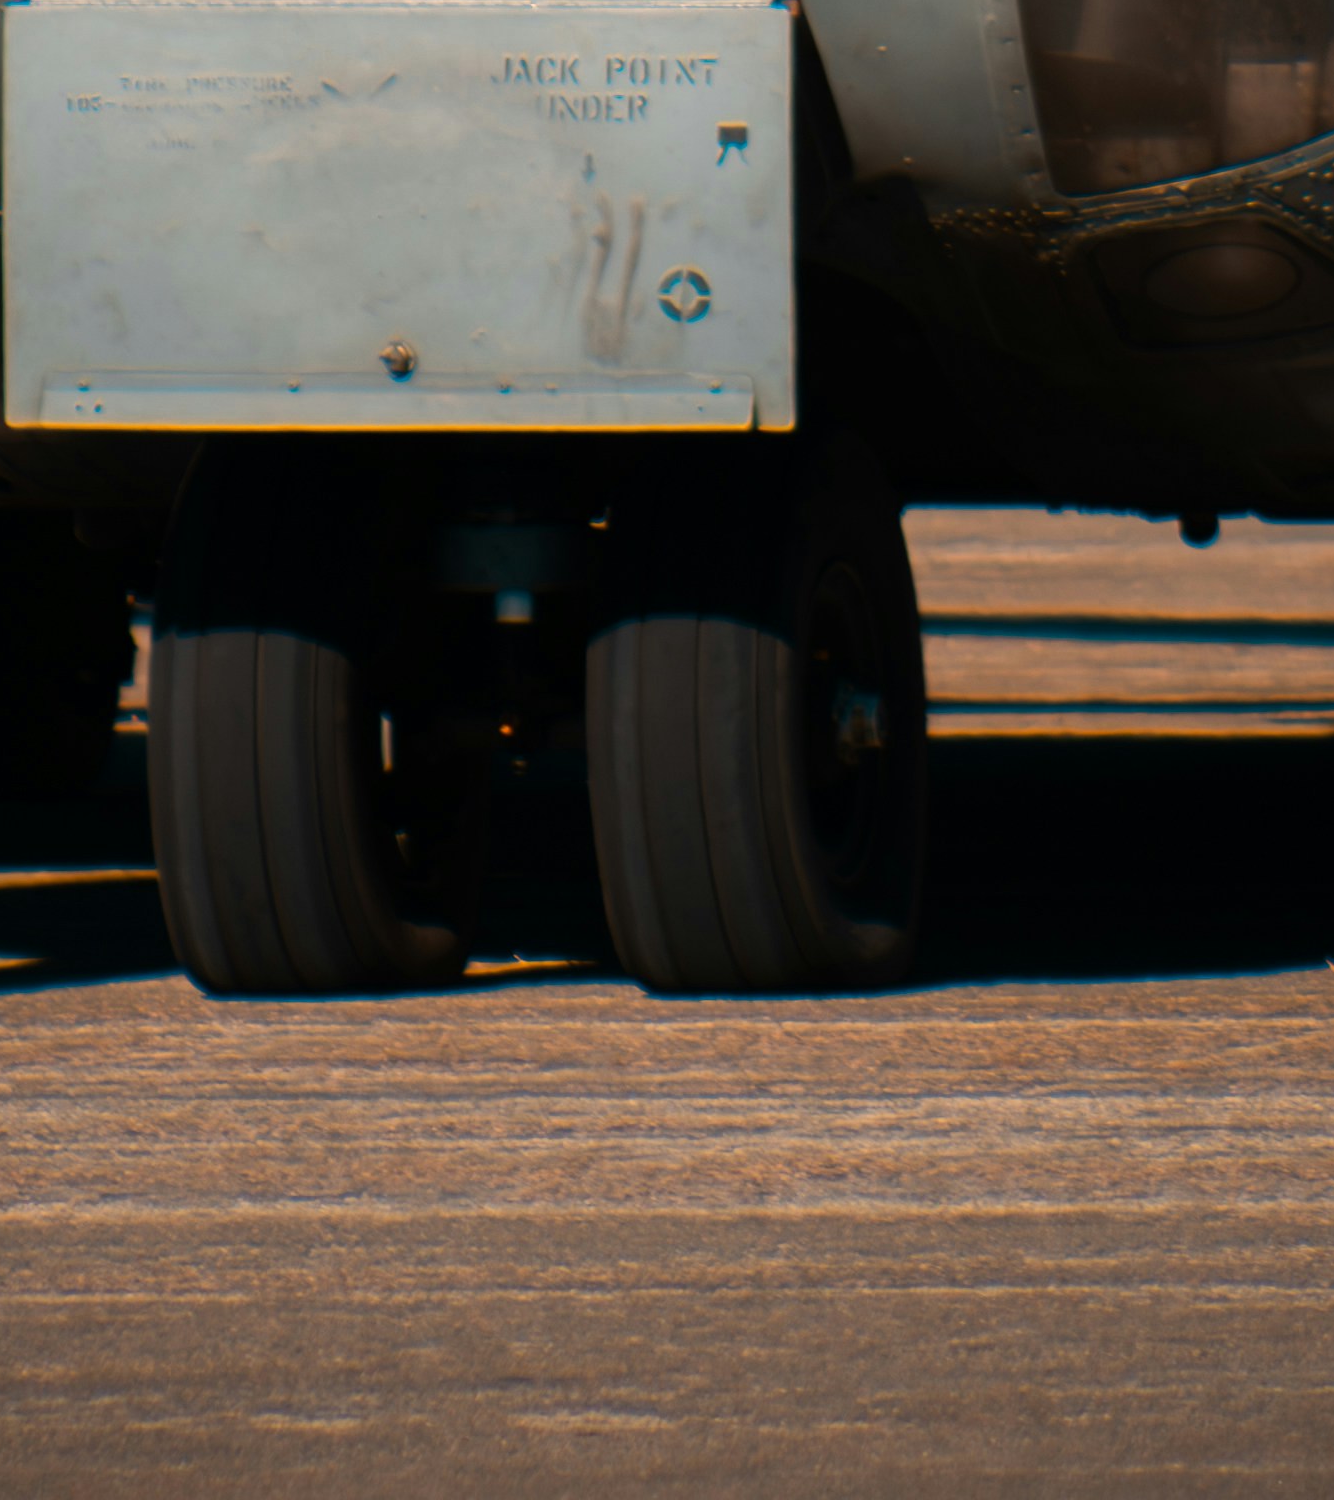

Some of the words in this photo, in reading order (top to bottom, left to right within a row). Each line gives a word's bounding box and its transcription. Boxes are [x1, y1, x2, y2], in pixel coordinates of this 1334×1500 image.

[490, 57, 580, 86] JACK
[606, 56, 719, 87] POINT
[535, 94, 649, 123] UNDER
